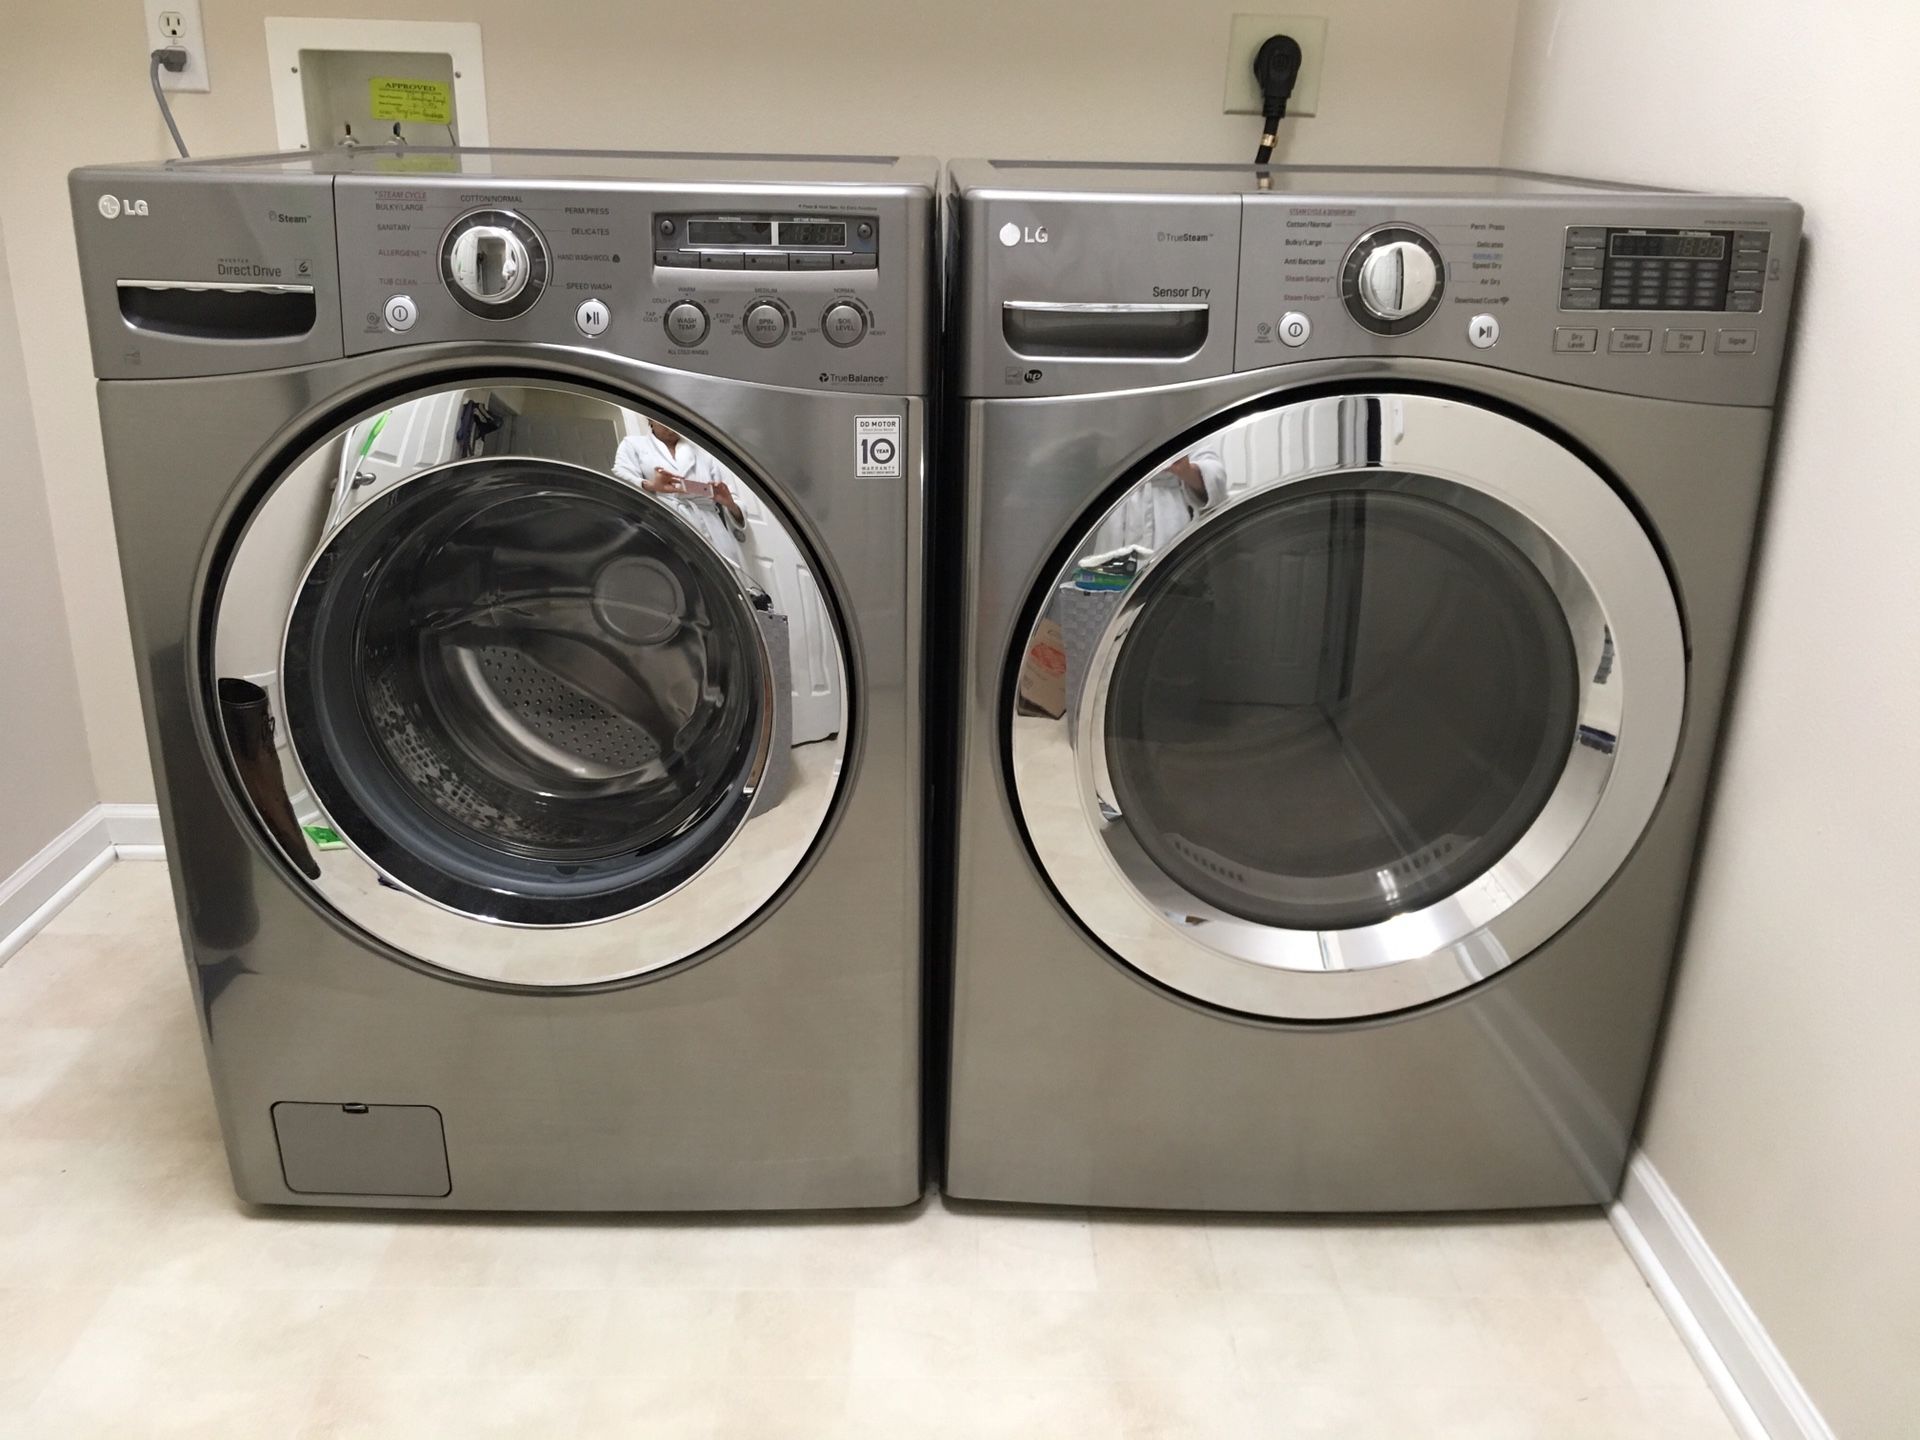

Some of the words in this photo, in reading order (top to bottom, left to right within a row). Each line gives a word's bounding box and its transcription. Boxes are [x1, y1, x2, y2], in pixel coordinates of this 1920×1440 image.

[384, 82, 437, 92] APPROVED
[460, 194, 523, 203] COTTON/NORMAL
[123, 199, 149, 216] LG
[375, 203, 424, 212] BULKY/LARGE
[571, 227, 610, 237] DELICATES
[1024, 225, 1049, 243] LG
[217, 263, 251, 277] Direct
[252, 264, 282, 278] Drive
[566, 282, 589, 290] SPEED
[1152, 286, 1189, 298] Sensor
[1191, 286, 1211, 300] Dry
